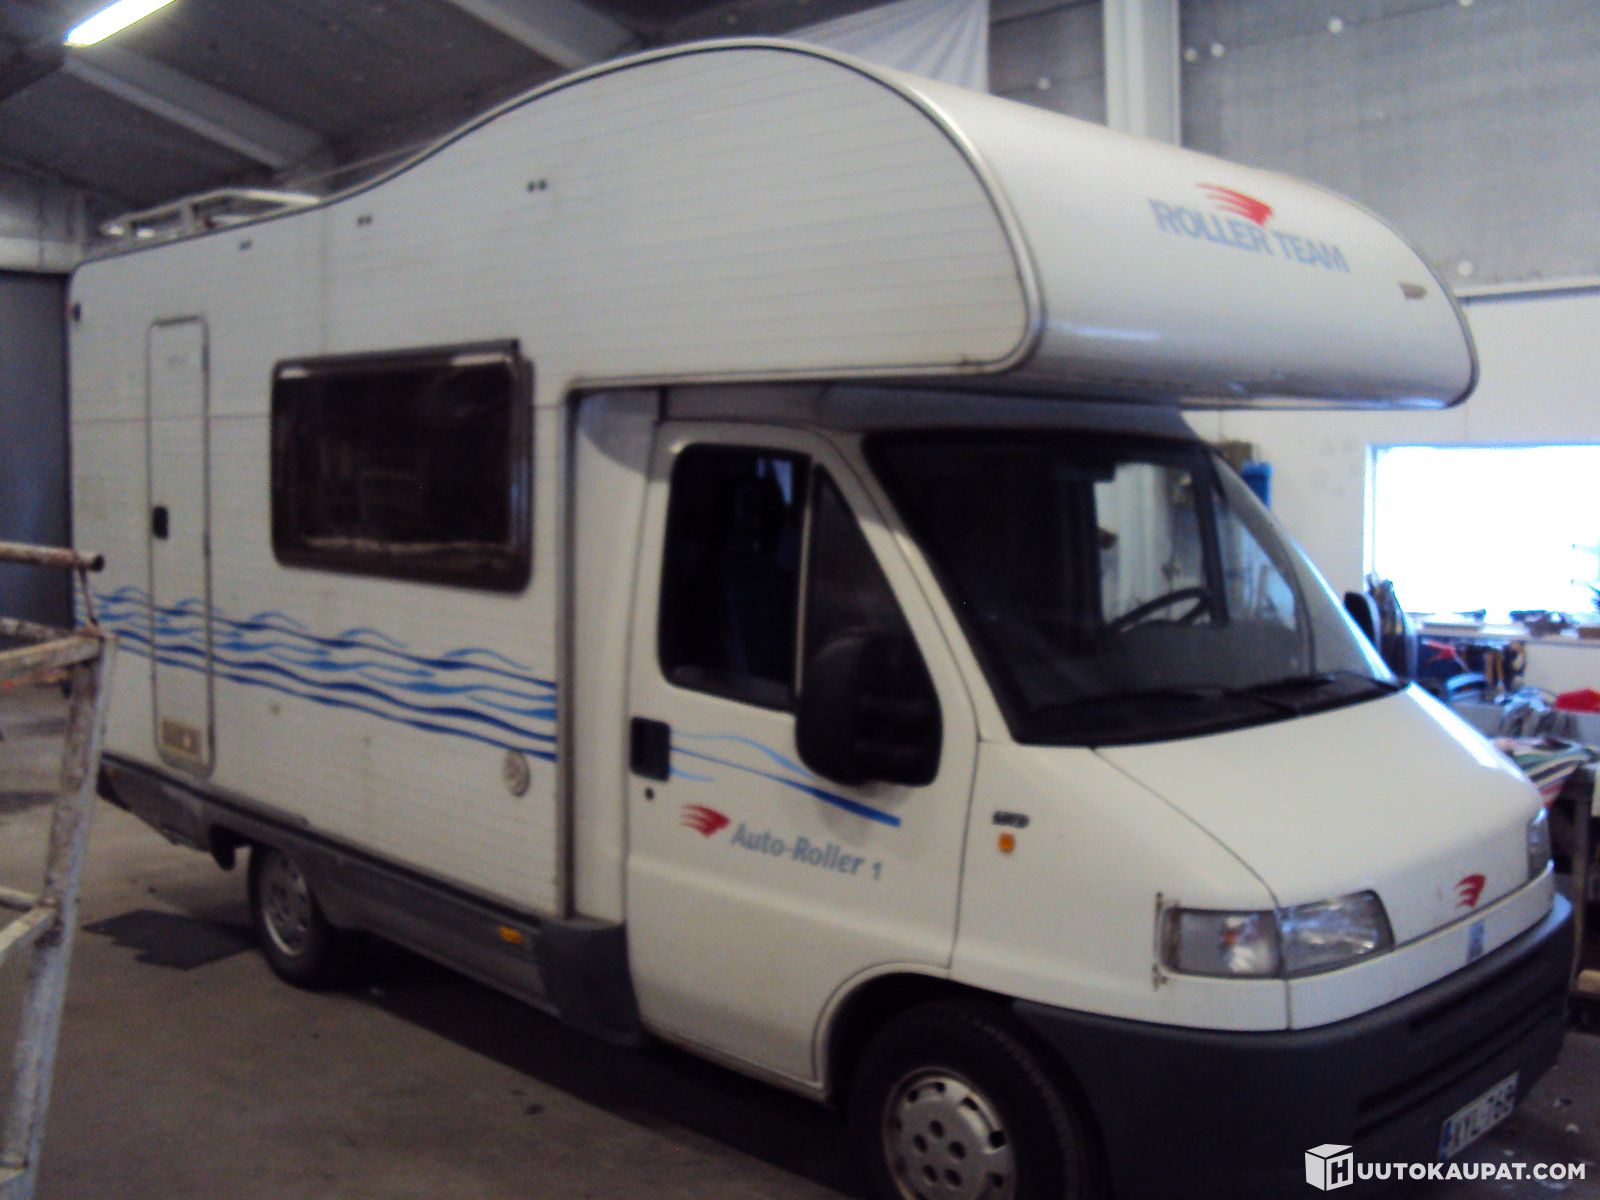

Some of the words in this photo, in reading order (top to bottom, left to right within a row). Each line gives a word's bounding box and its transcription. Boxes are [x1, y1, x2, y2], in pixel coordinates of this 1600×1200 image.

[1148, 199, 1274, 256] ROLLER
[1271, 230, 1351, 273] TEAM
[731, 823, 865, 876] Auto-Roller
